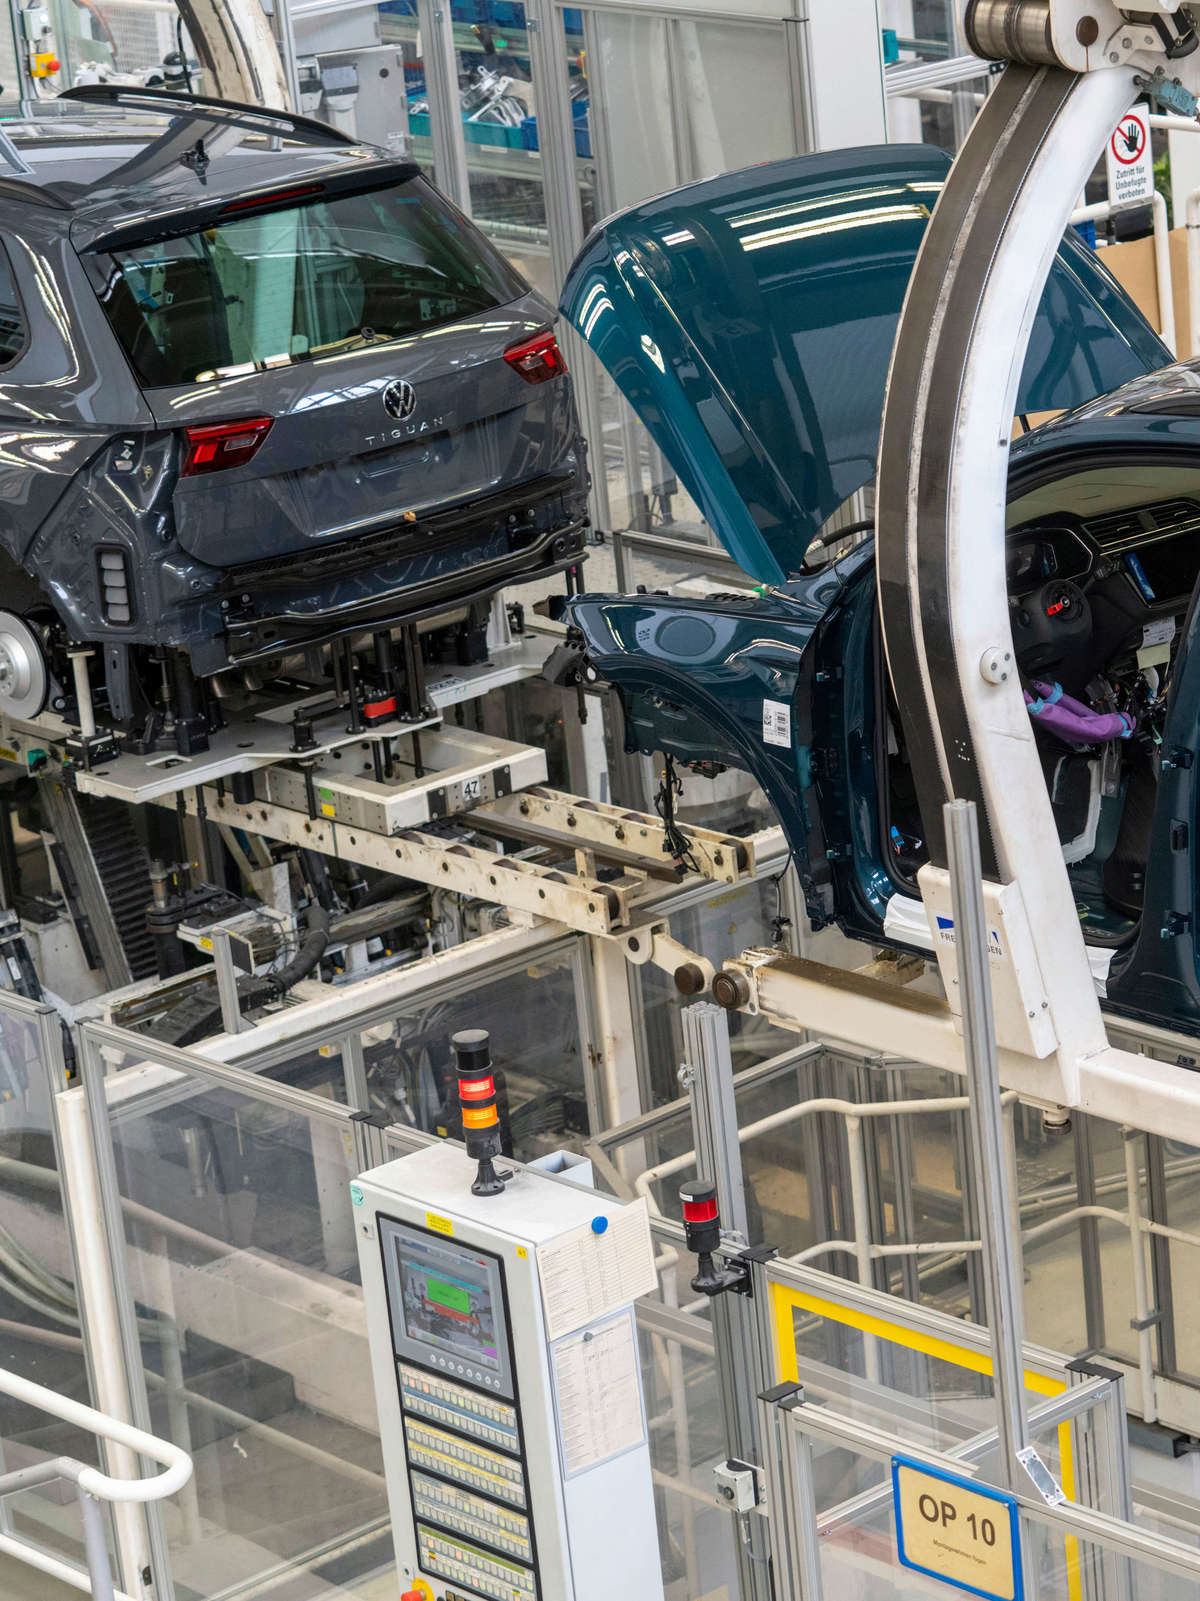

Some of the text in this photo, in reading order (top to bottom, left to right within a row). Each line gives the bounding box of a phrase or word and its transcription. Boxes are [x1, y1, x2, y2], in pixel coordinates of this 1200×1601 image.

[1115, 166, 1145, 179] Zutritt für
[1115, 177, 1147, 190] Unbefugte
[1118, 188, 1145, 200] verboten
[364, 416, 444, 447] TIGUAN
[464, 781, 478, 795] 47
[919, 1494, 996, 1547] OP 10
